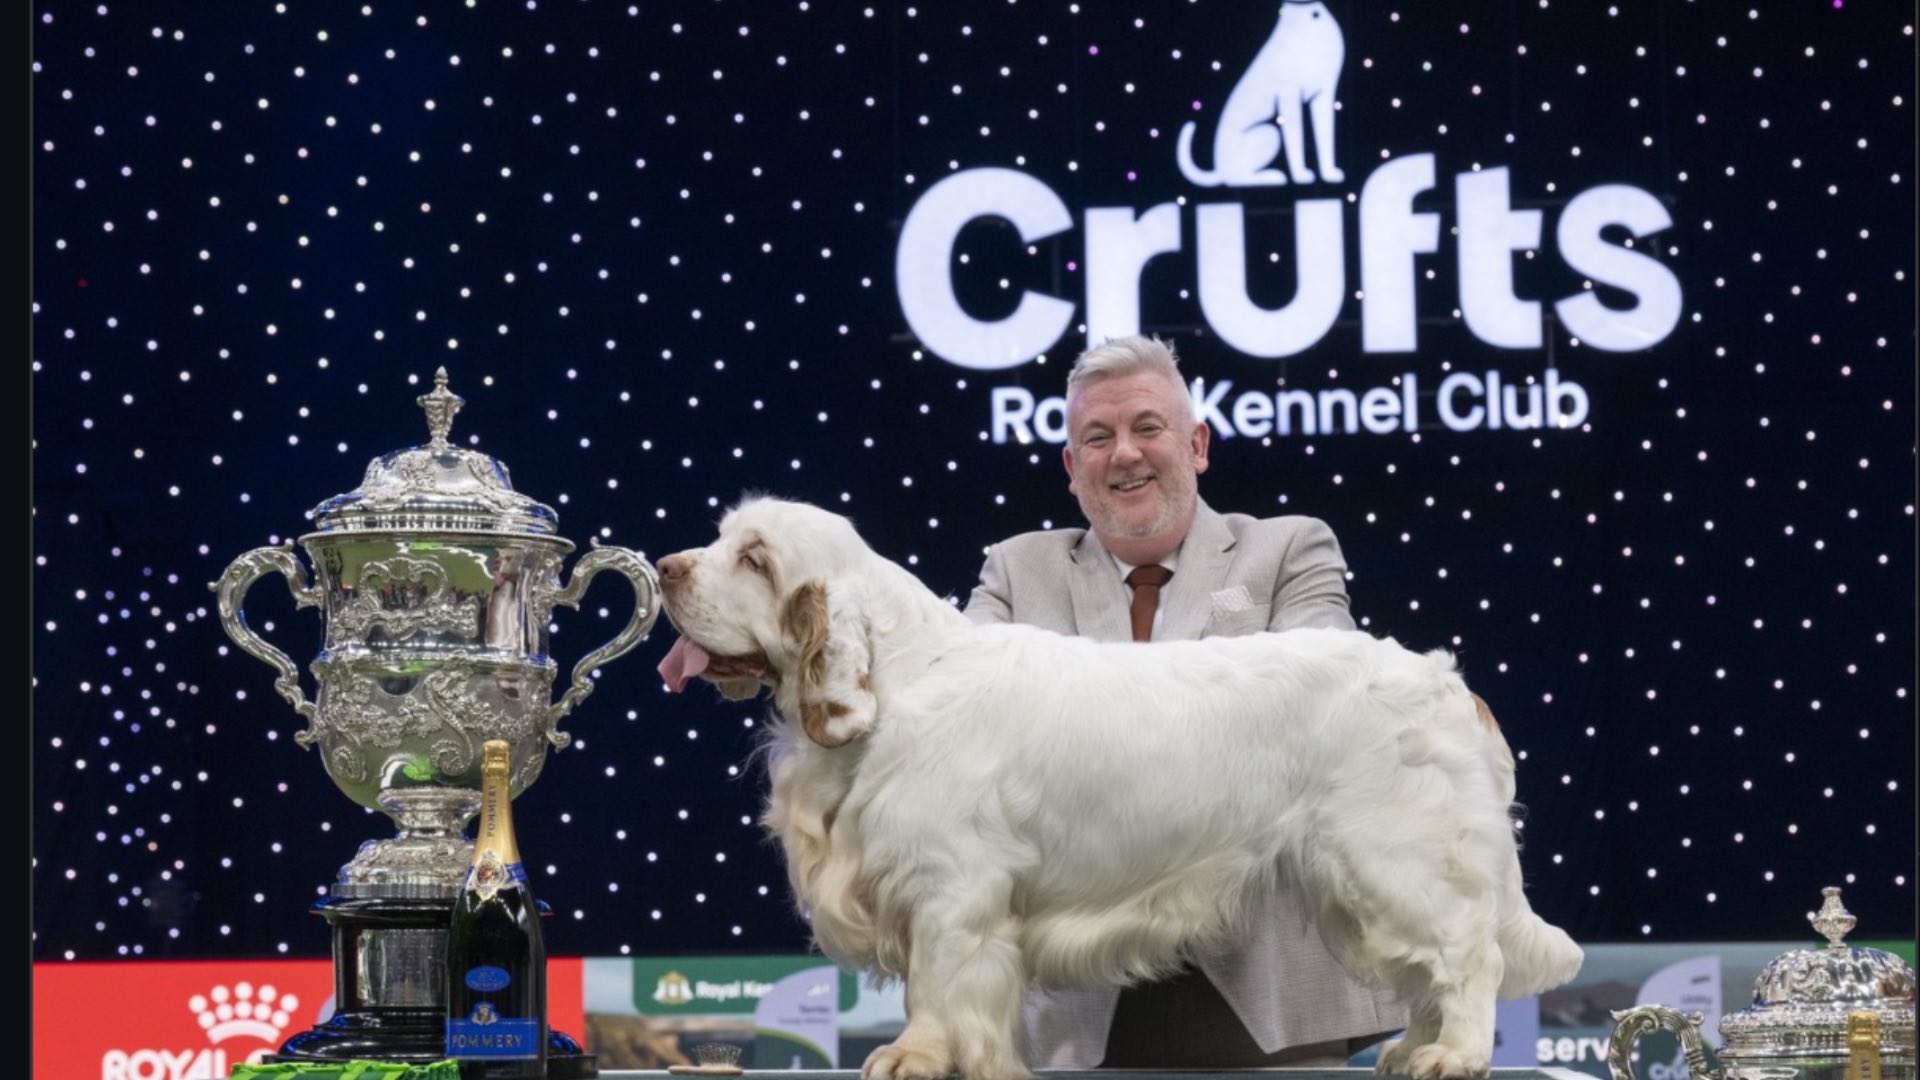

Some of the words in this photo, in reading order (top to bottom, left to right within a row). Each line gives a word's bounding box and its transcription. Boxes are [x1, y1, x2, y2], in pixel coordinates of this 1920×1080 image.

[896, 153, 1684, 370] Crufts
[1190, 372, 1418, 438] Kennel
[1437, 369, 1589, 432] Club
[695, 980, 741, 1002] Royal
[452, 1034, 522, 1048] POMMERY
